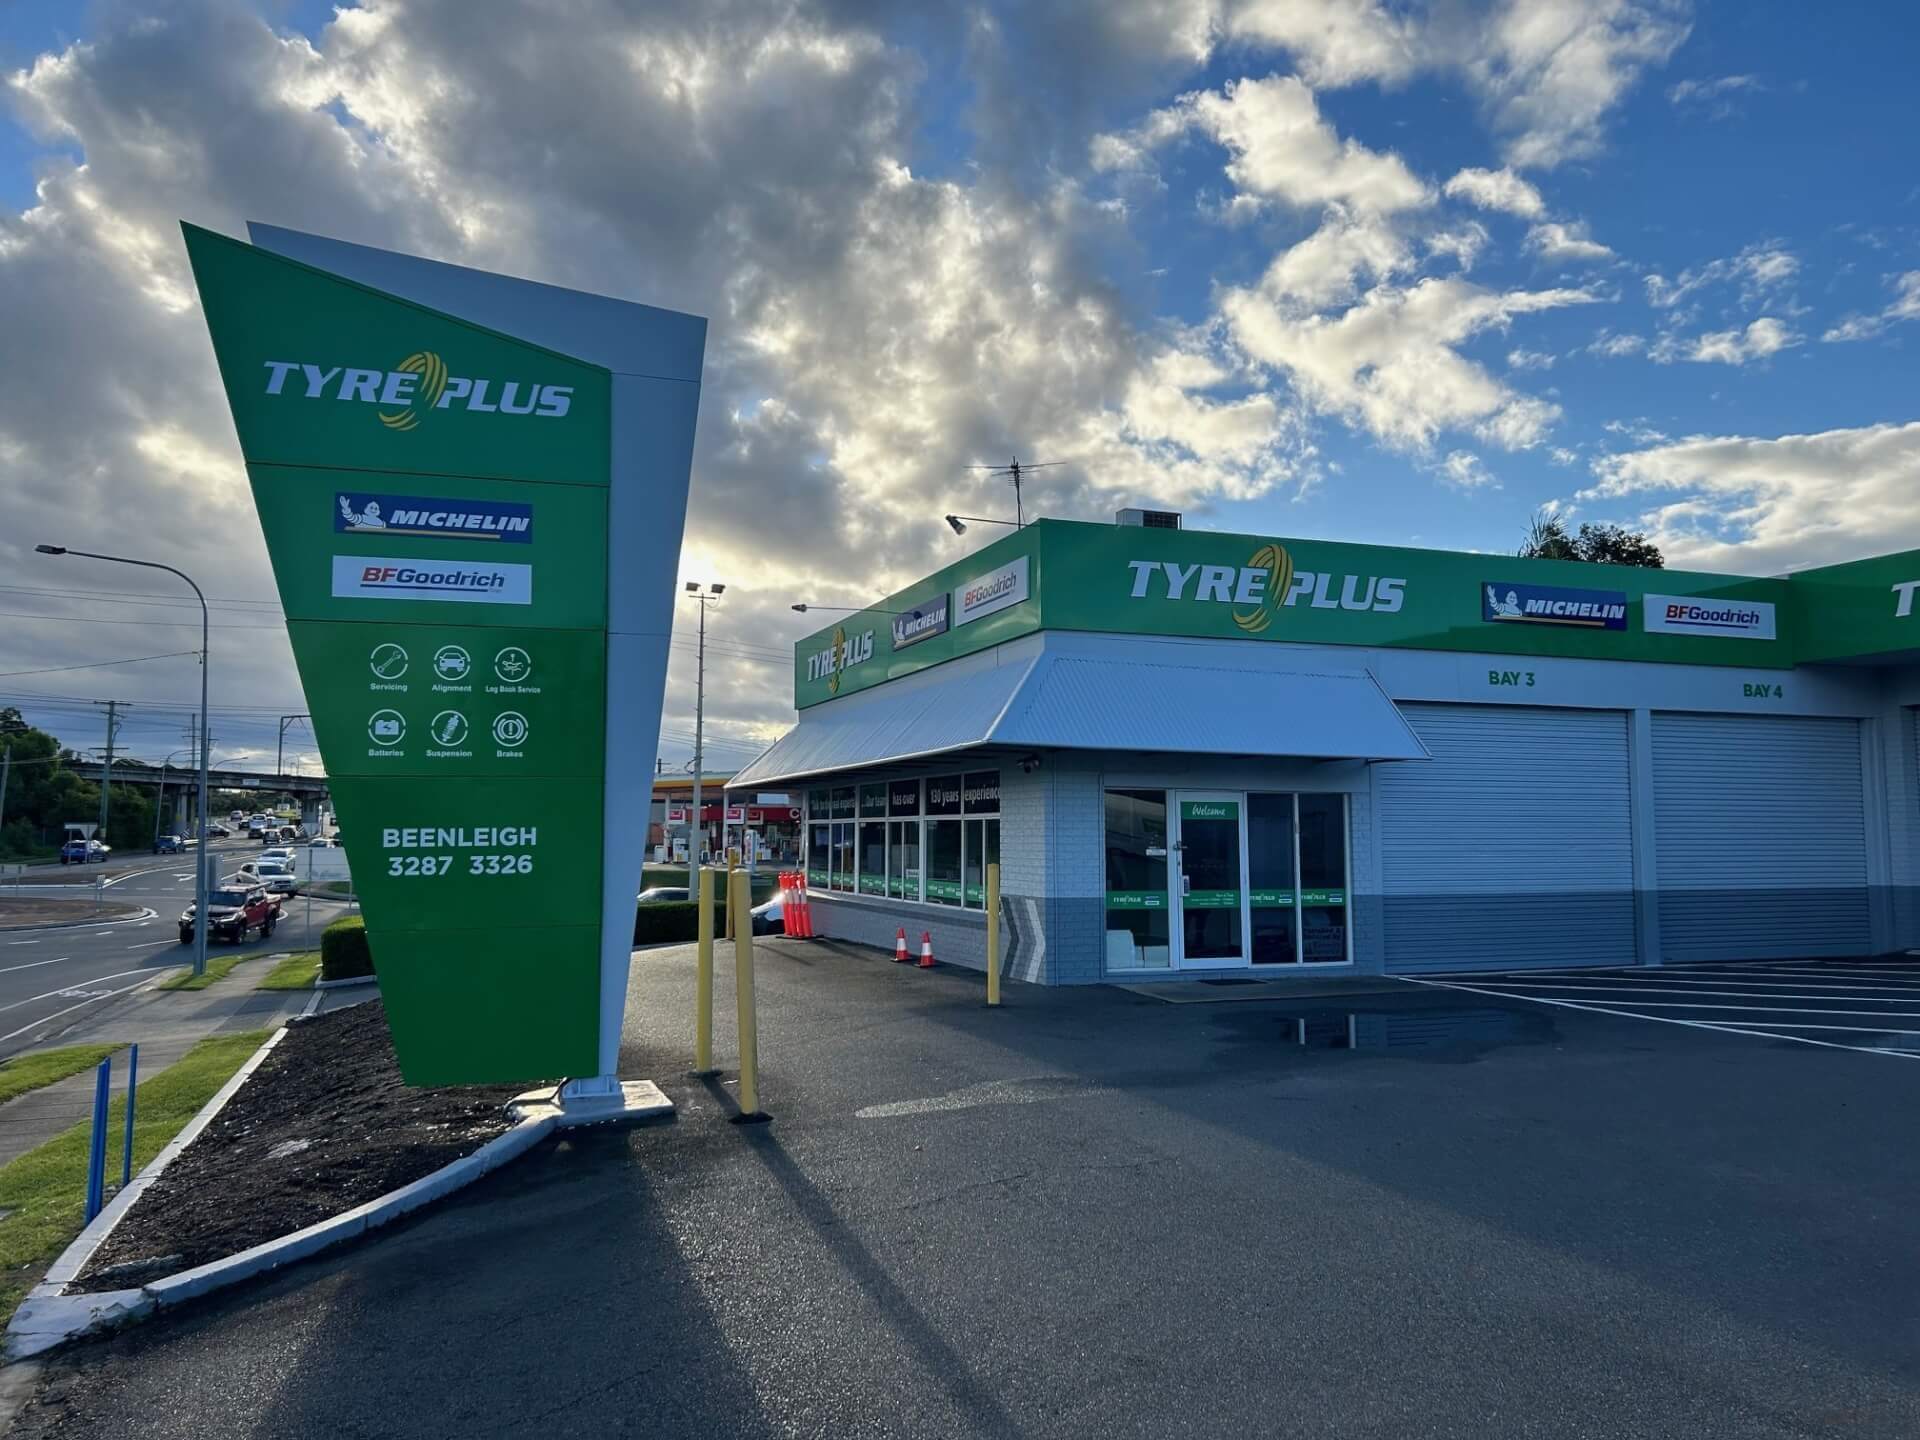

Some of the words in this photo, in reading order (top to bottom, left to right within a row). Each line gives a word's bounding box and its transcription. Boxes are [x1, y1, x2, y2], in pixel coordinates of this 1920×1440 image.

[390, 509, 530, 532] MICHELIN
[362, 567, 505, 588] BFGoodrich
[965, 571, 1017, 607] BFGoodrich
[1524, 599, 1626, 619] MICHELIN
[1665, 603, 1760, 625] BFGoodrich
[905, 607, 946, 635] MICHELIN
[370, 682, 408, 692] Servicing
[1488, 670, 1520, 687] BAY
[1525, 672, 1536, 687] 3
[431, 683, 472, 693] Alignment
[486, 685, 498, 694] Log
[499, 685, 517, 693] Book
[517, 686, 541, 694] Service
[1743, 683, 1770, 698] BAY
[1771, 685, 1783, 699] 4
[368, 749, 404, 757] Batteries
[426, 749, 473, 758] Suspension
[496, 750, 523, 758] Brakes
[941, 790, 959, 807] years
[1192, 804, 1225, 817] Welcome
[383, 827, 537, 848] BEENLEIGH
[388, 855, 453, 876] 3287
[469, 854, 533, 875] 3326
